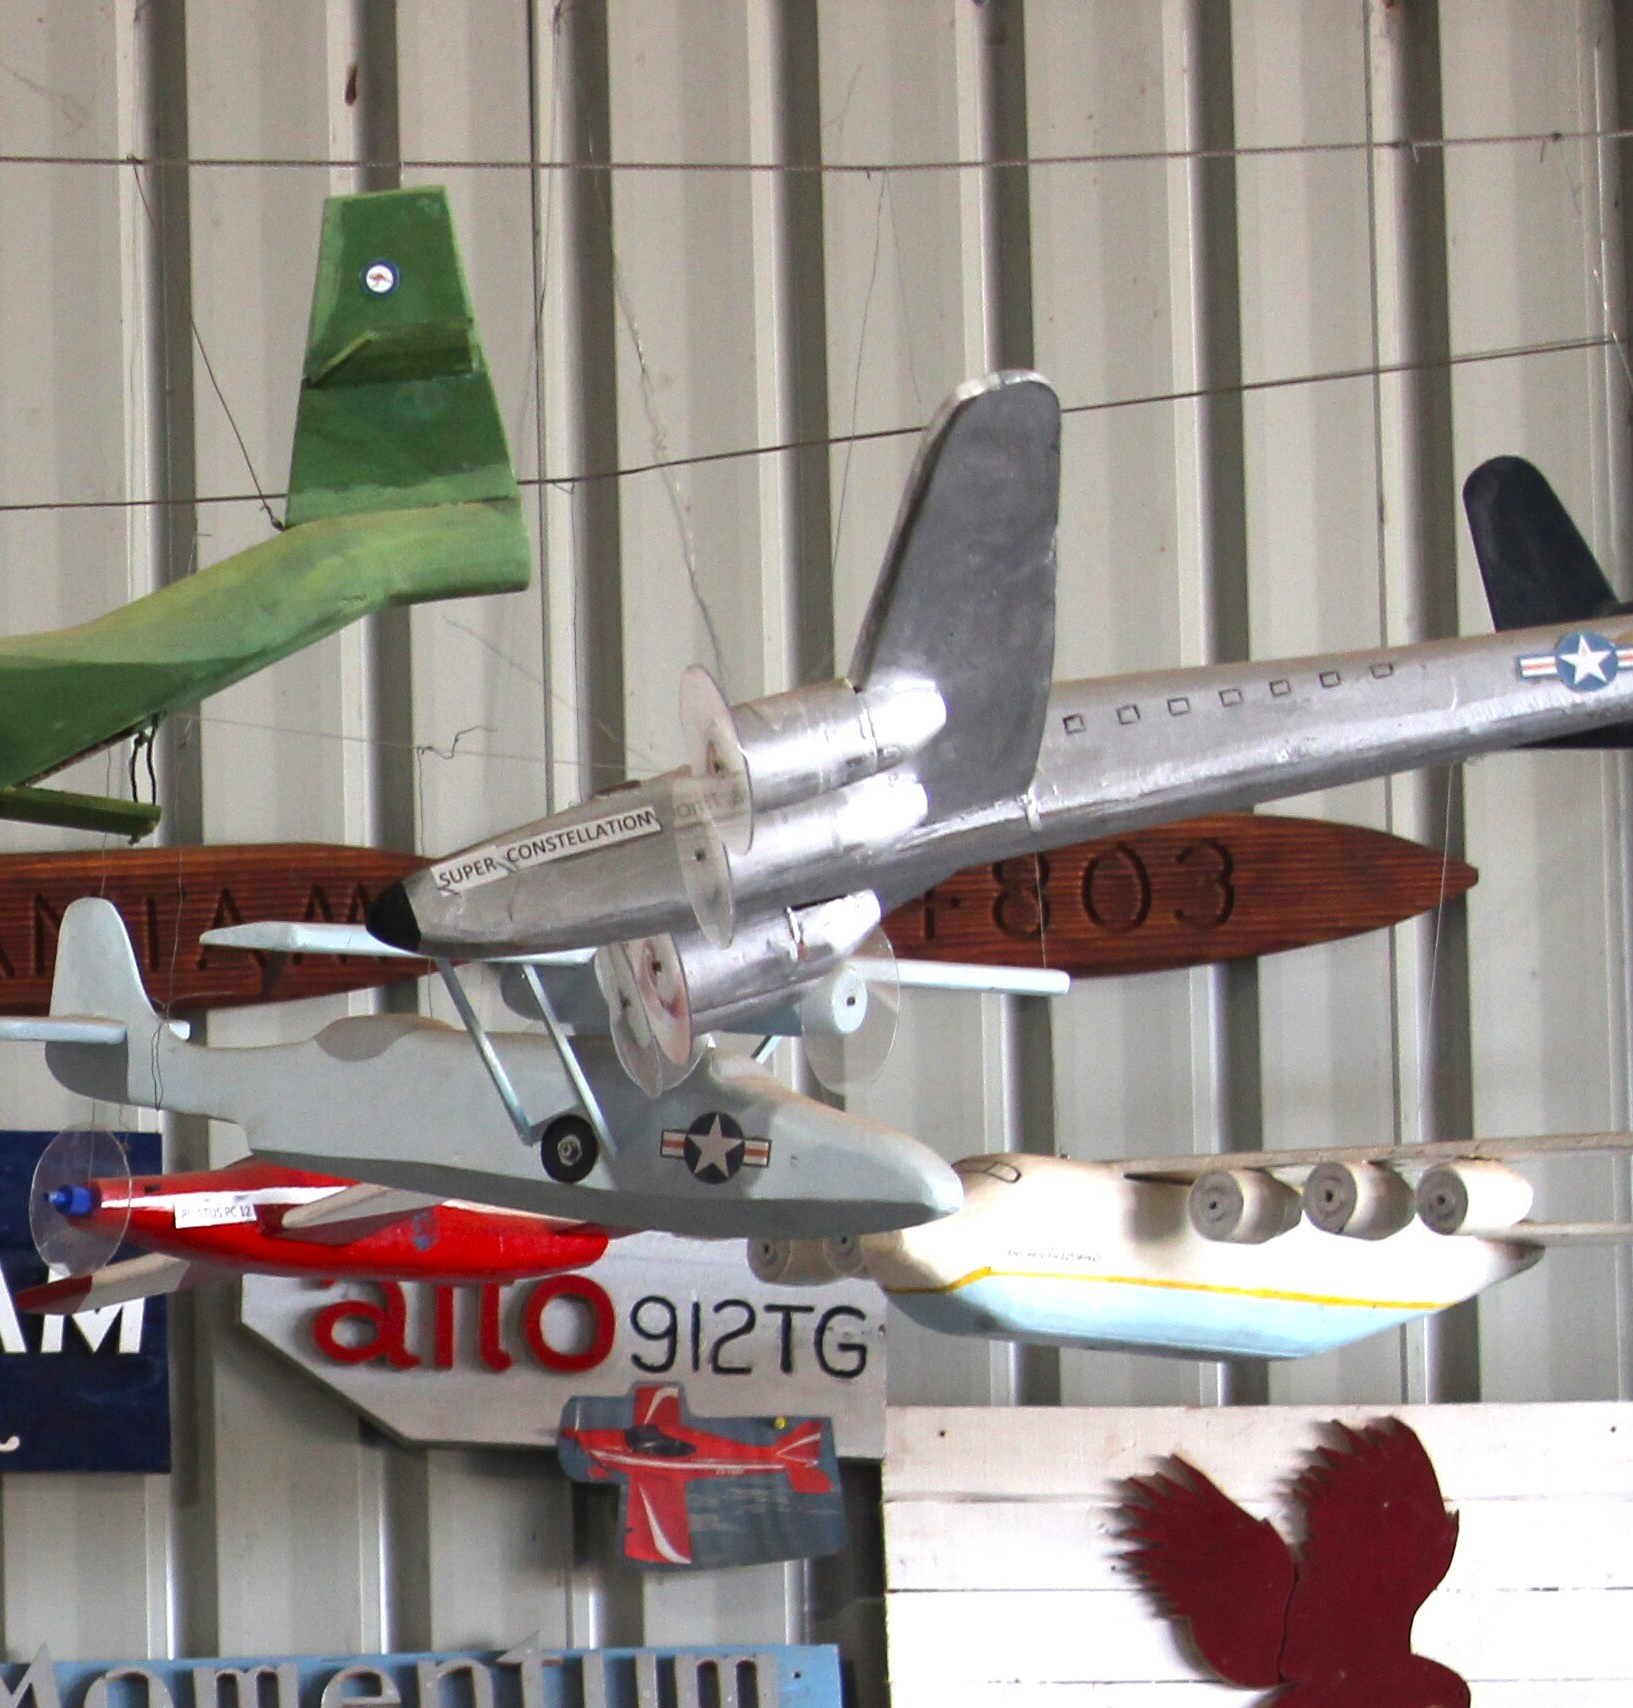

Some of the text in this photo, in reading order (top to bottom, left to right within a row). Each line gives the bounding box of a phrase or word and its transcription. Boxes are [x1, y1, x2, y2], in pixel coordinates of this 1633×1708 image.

[438, 810, 654, 886] SUPER CONSTELLATION
[629, 1295, 870, 1380] 912TG
